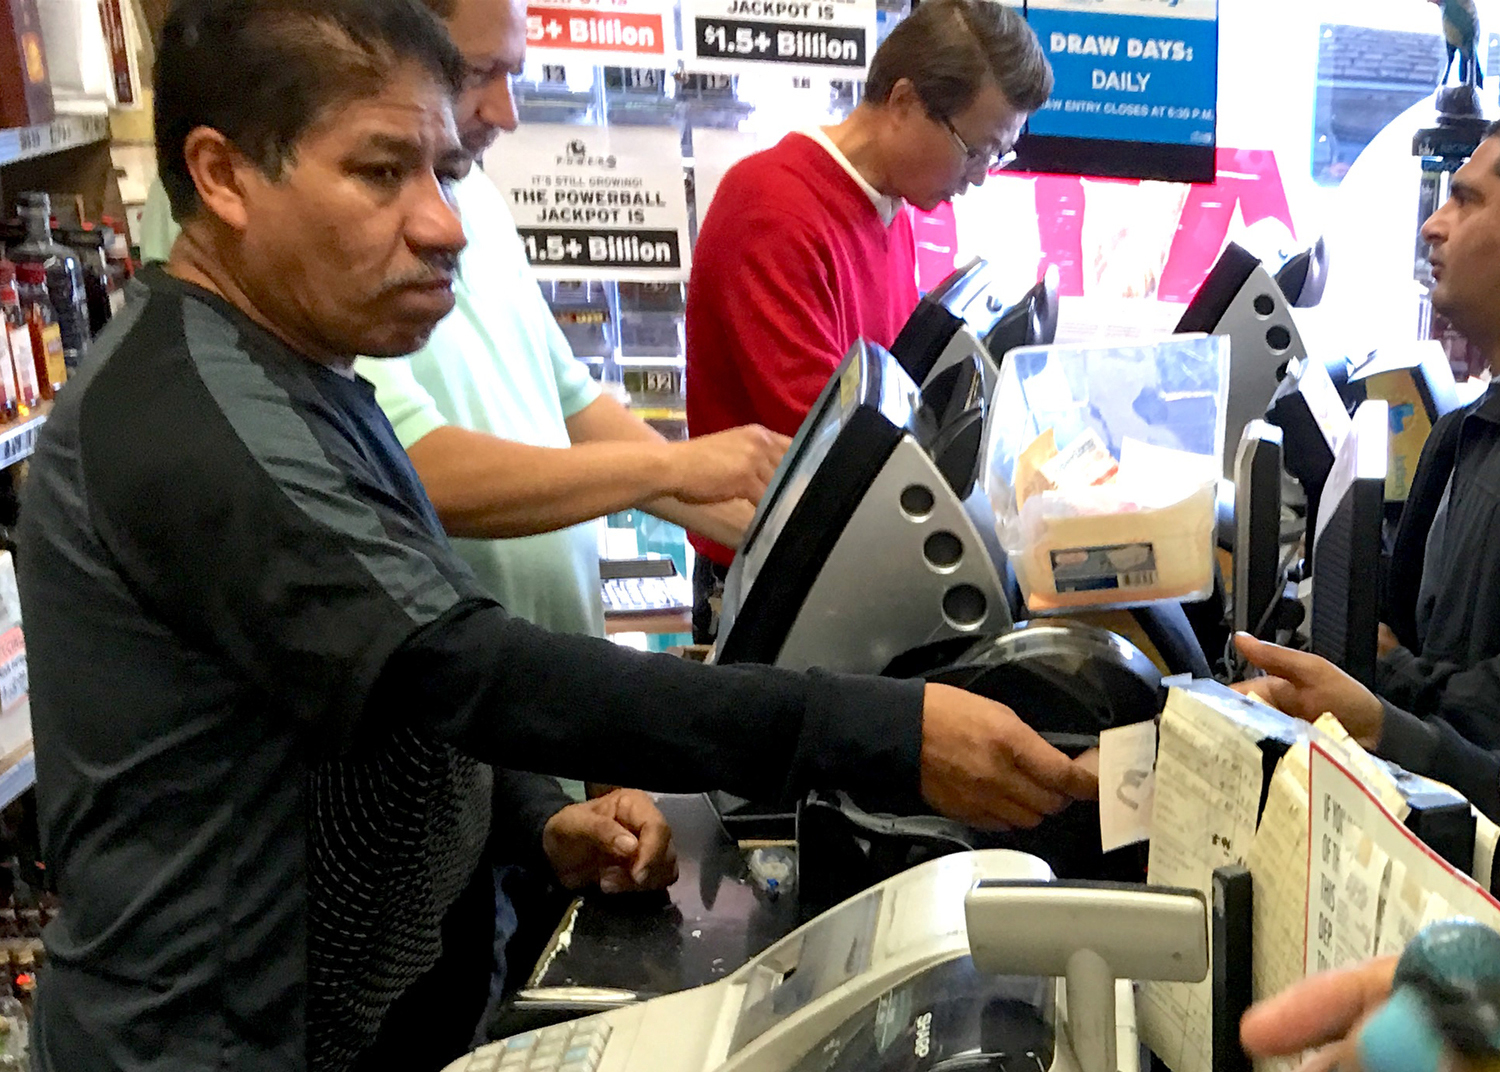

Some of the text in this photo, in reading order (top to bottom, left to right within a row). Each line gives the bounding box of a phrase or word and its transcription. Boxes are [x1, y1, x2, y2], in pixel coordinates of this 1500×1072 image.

[727, 0, 834, 20] JACKPOT IS
[569, 17, 655, 47] Billion
[704, 24, 858, 60] $1.5+ Billion
[1050, 32, 1193, 62] DRAW DAYS:
[1091, 68, 1151, 93] DAILY
[1064, 100, 1101, 113] ENTRY
[1103, 103, 1149, 117] CLOSES
[1151, 105, 1167, 117] AT
[555, 175, 586, 188] STILL
[510, 188, 667, 208] THE POWERBALL
[537, 207, 645, 224] JACKPOT IS
[588, 235, 671, 263] Billion
[914, 1011, 932, 1059] SHARP
